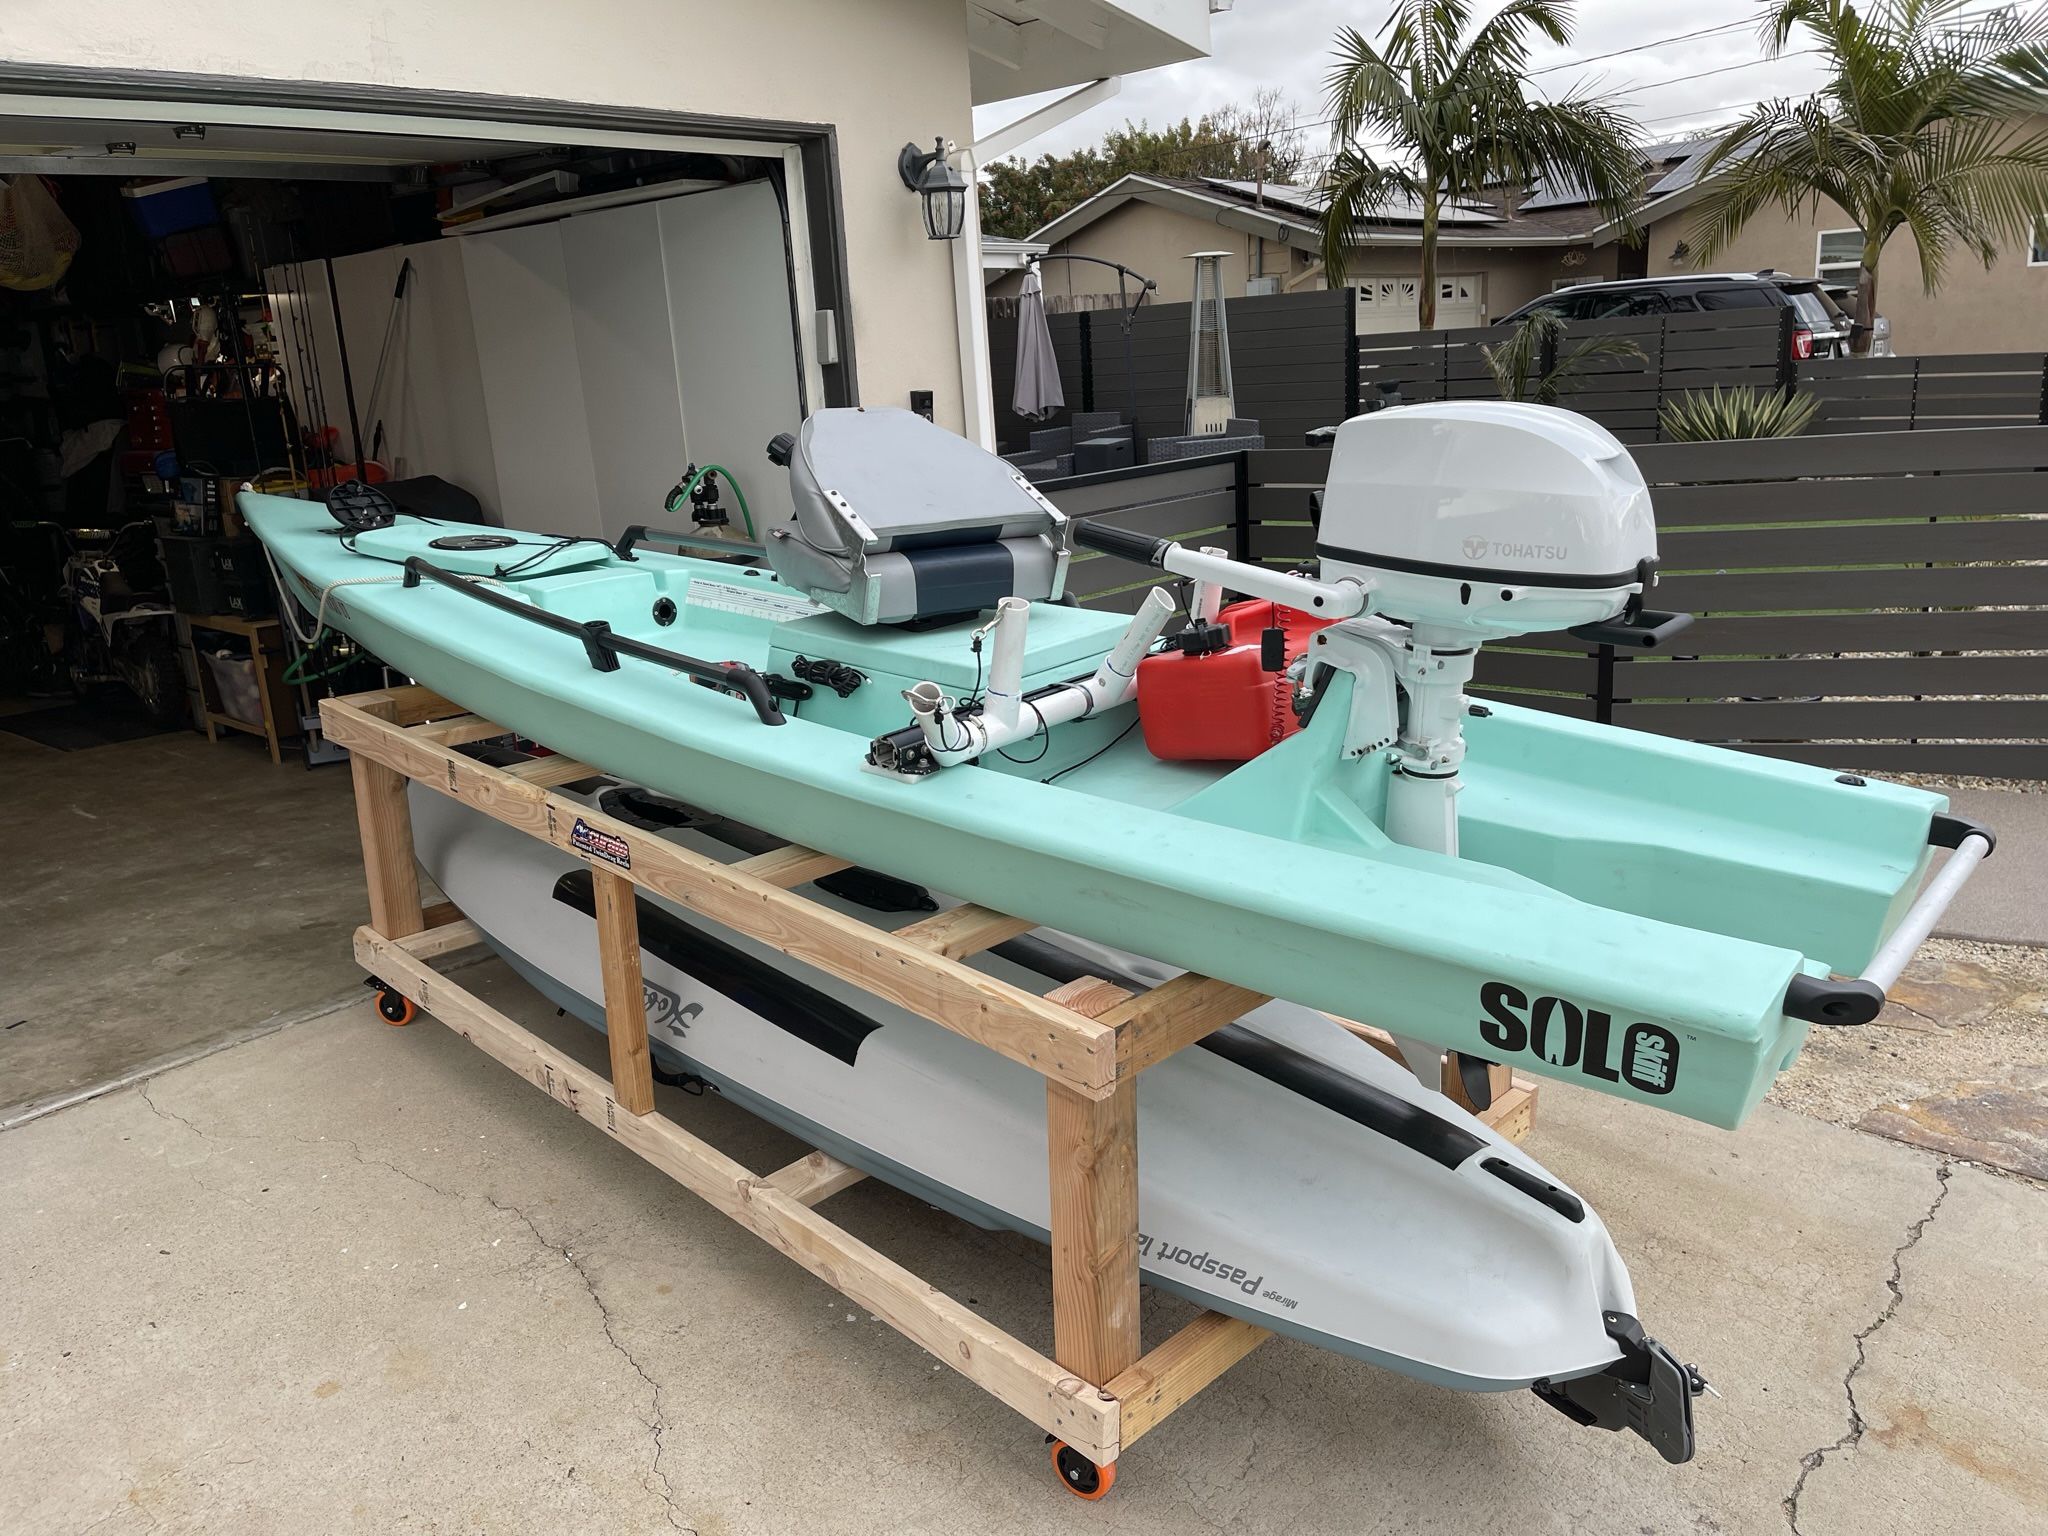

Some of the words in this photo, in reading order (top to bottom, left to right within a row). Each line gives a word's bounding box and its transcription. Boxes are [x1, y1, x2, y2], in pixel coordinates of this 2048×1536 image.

[1493, 542, 1567, 560] TOHATSU
[1480, 981, 1680, 1095] SOLO
[1157, 1242, 1263, 1295] Passport
[1263, 1290, 1298, 1309] Mirage
